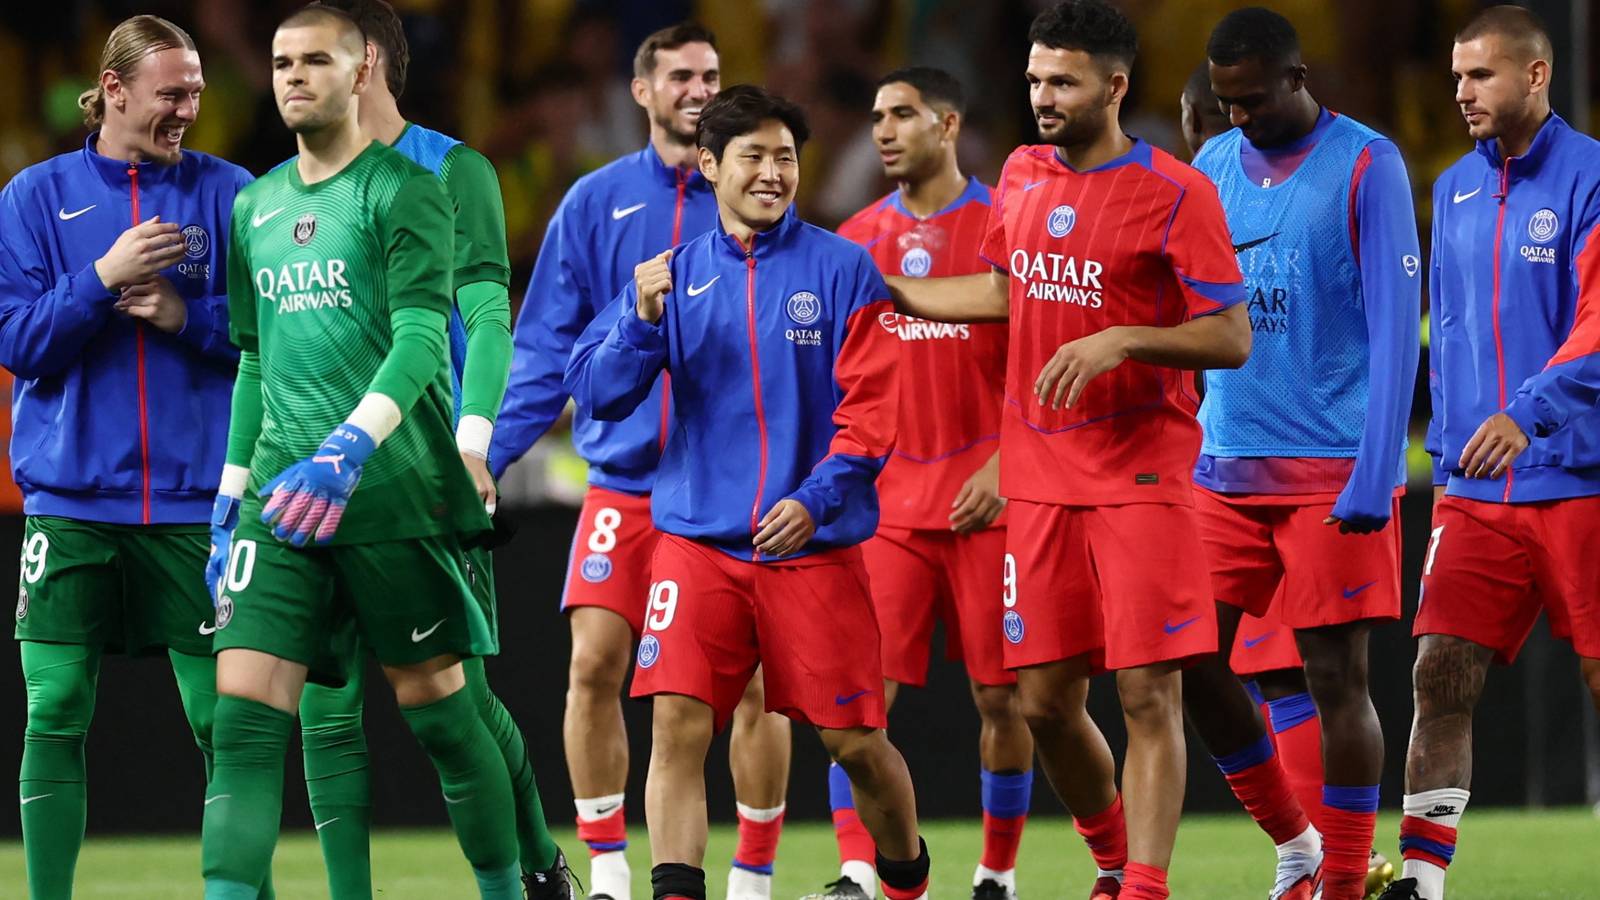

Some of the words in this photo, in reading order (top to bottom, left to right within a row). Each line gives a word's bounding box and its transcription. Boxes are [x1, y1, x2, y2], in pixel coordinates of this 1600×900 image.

[1520, 245, 1556, 258] QATAR
[177, 263, 210, 275] QATAR
[256, 259, 350, 302] QATAR
[1010, 249, 1103, 290] QATAR
[278, 289, 353, 314] AIRWAYS
[1026, 281, 1102, 308] AIRWAYS
[1245, 287, 1287, 316] AR
[785, 329, 822, 341] QATAR
[588, 507, 622, 553] 8
[1433, 804, 1457, 813] NIKE
